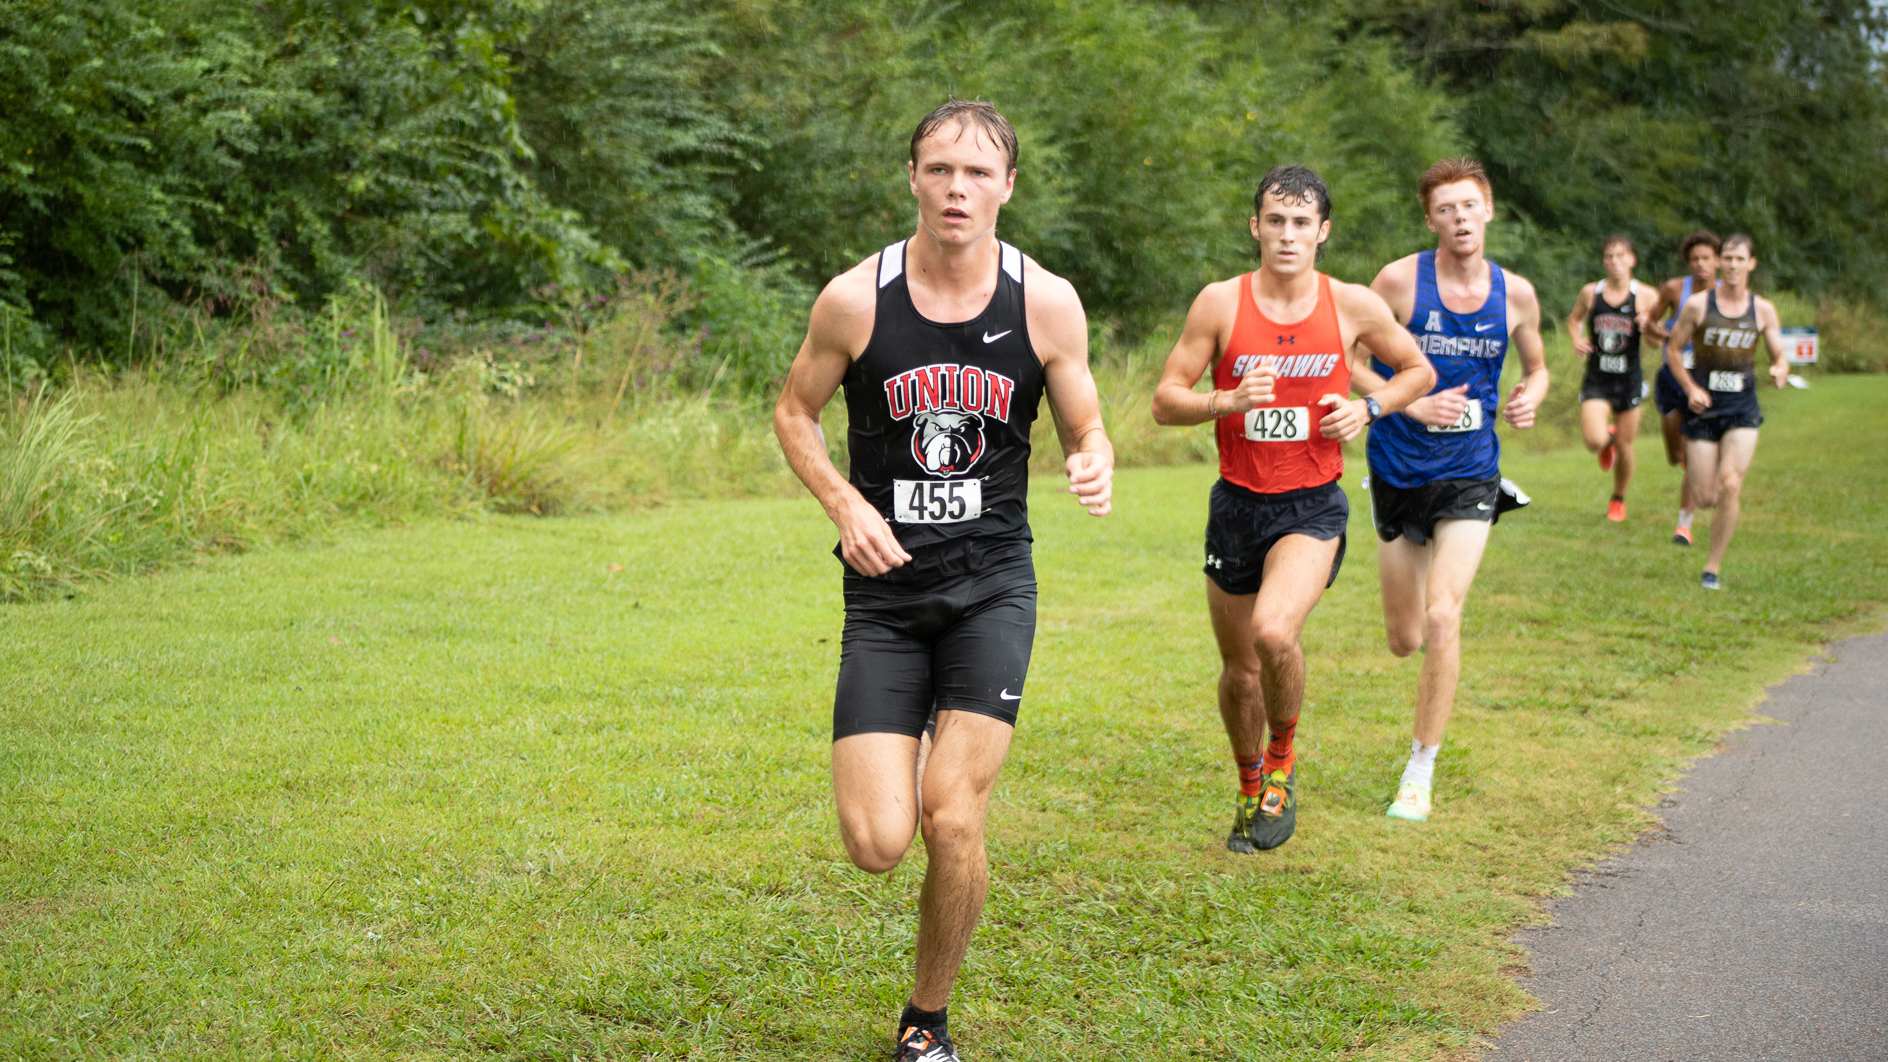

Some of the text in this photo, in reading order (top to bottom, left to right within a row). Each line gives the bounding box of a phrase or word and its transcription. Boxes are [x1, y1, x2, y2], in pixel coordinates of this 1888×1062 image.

[1413, 334, 1501, 358] MEMPHIS
[884, 364, 1014, 424] UNION
[1253, 409, 1297, 438] 428
[908, 482, 966, 521] 455
